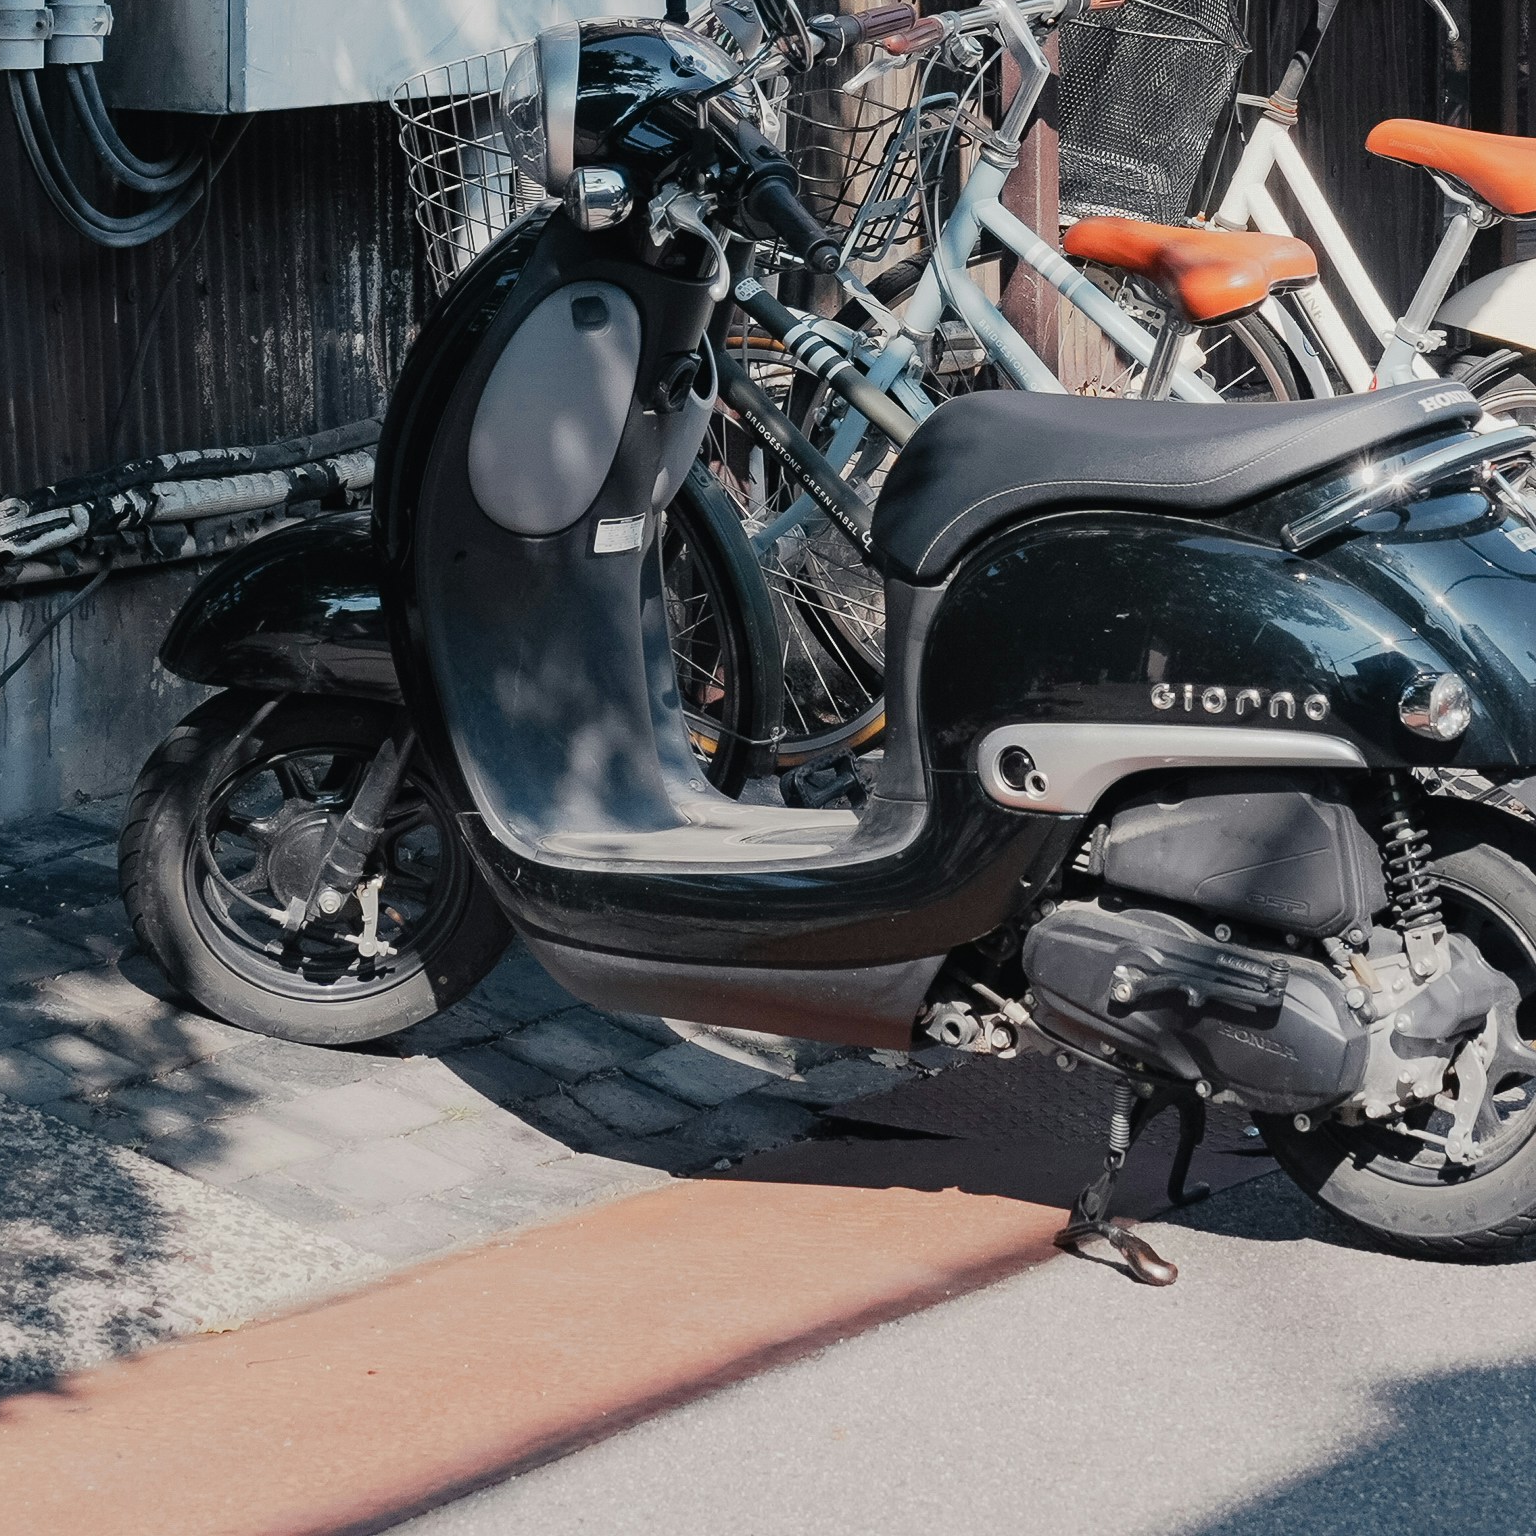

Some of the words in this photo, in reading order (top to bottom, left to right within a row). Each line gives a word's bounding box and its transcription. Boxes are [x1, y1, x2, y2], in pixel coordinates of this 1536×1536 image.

[978, 319, 1031, 381] BRIDGESTONE
[745, 410, 802, 474] BRIDGESTONE
[802, 473, 833, 507] GREEN
[831, 503, 858, 537] LABEL
[1150, 682, 1331, 722] Giorno
[1217, 1020, 1299, 1062] HONDA
